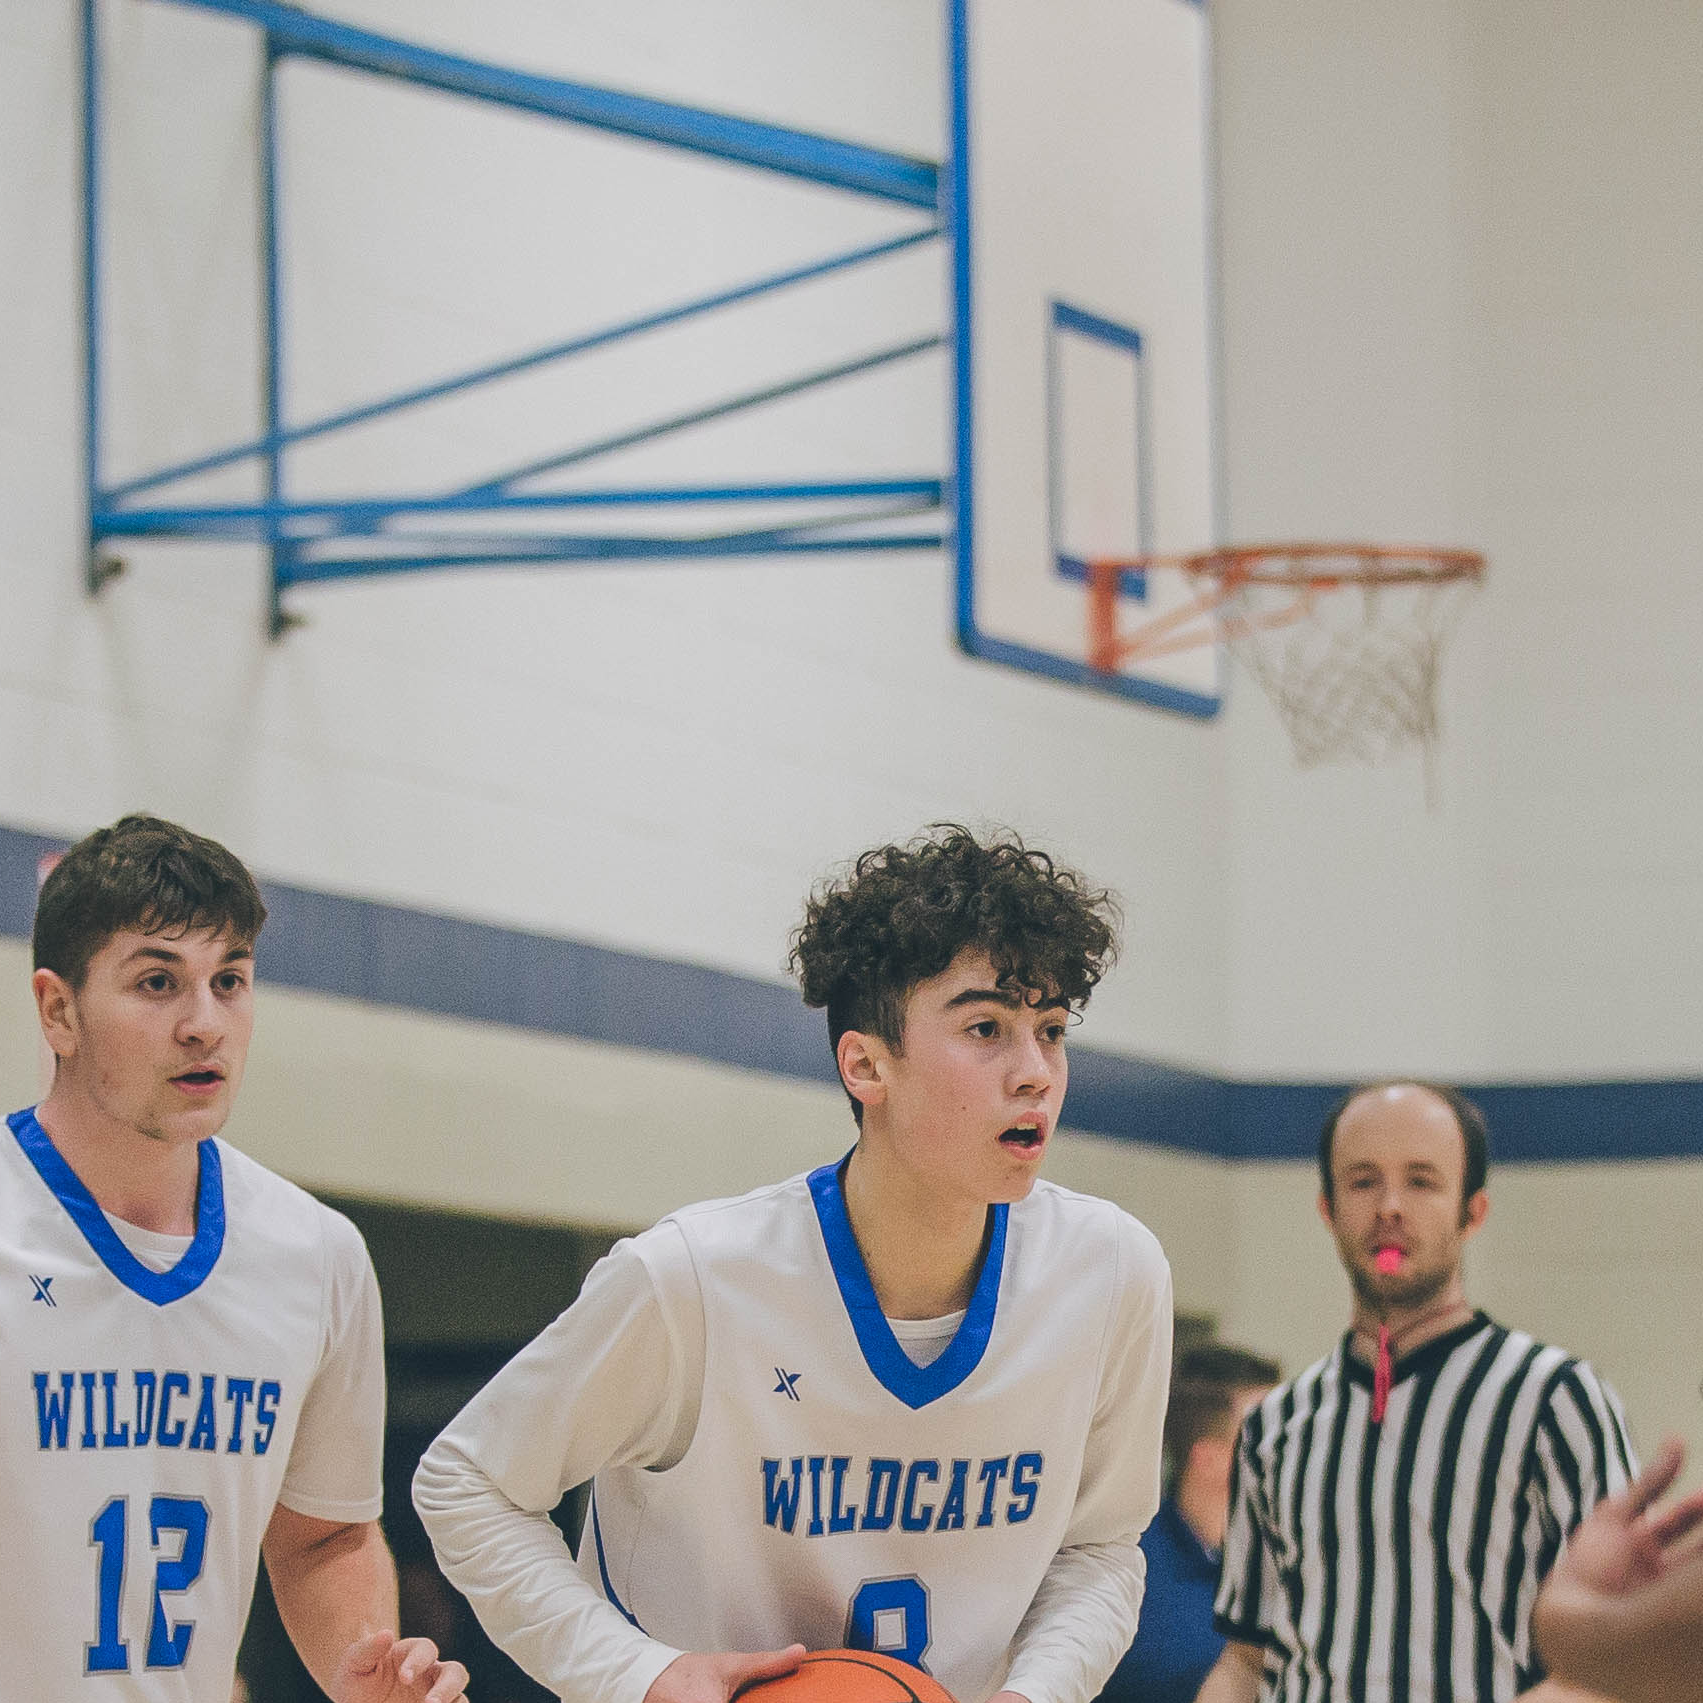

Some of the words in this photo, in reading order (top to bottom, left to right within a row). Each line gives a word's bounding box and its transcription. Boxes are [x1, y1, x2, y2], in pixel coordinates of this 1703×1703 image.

[33, 1369, 281, 1455] WILDCATS
[760, 1450, 1044, 1537] WILDCATS
[83, 1493, 212, 1677] 12
